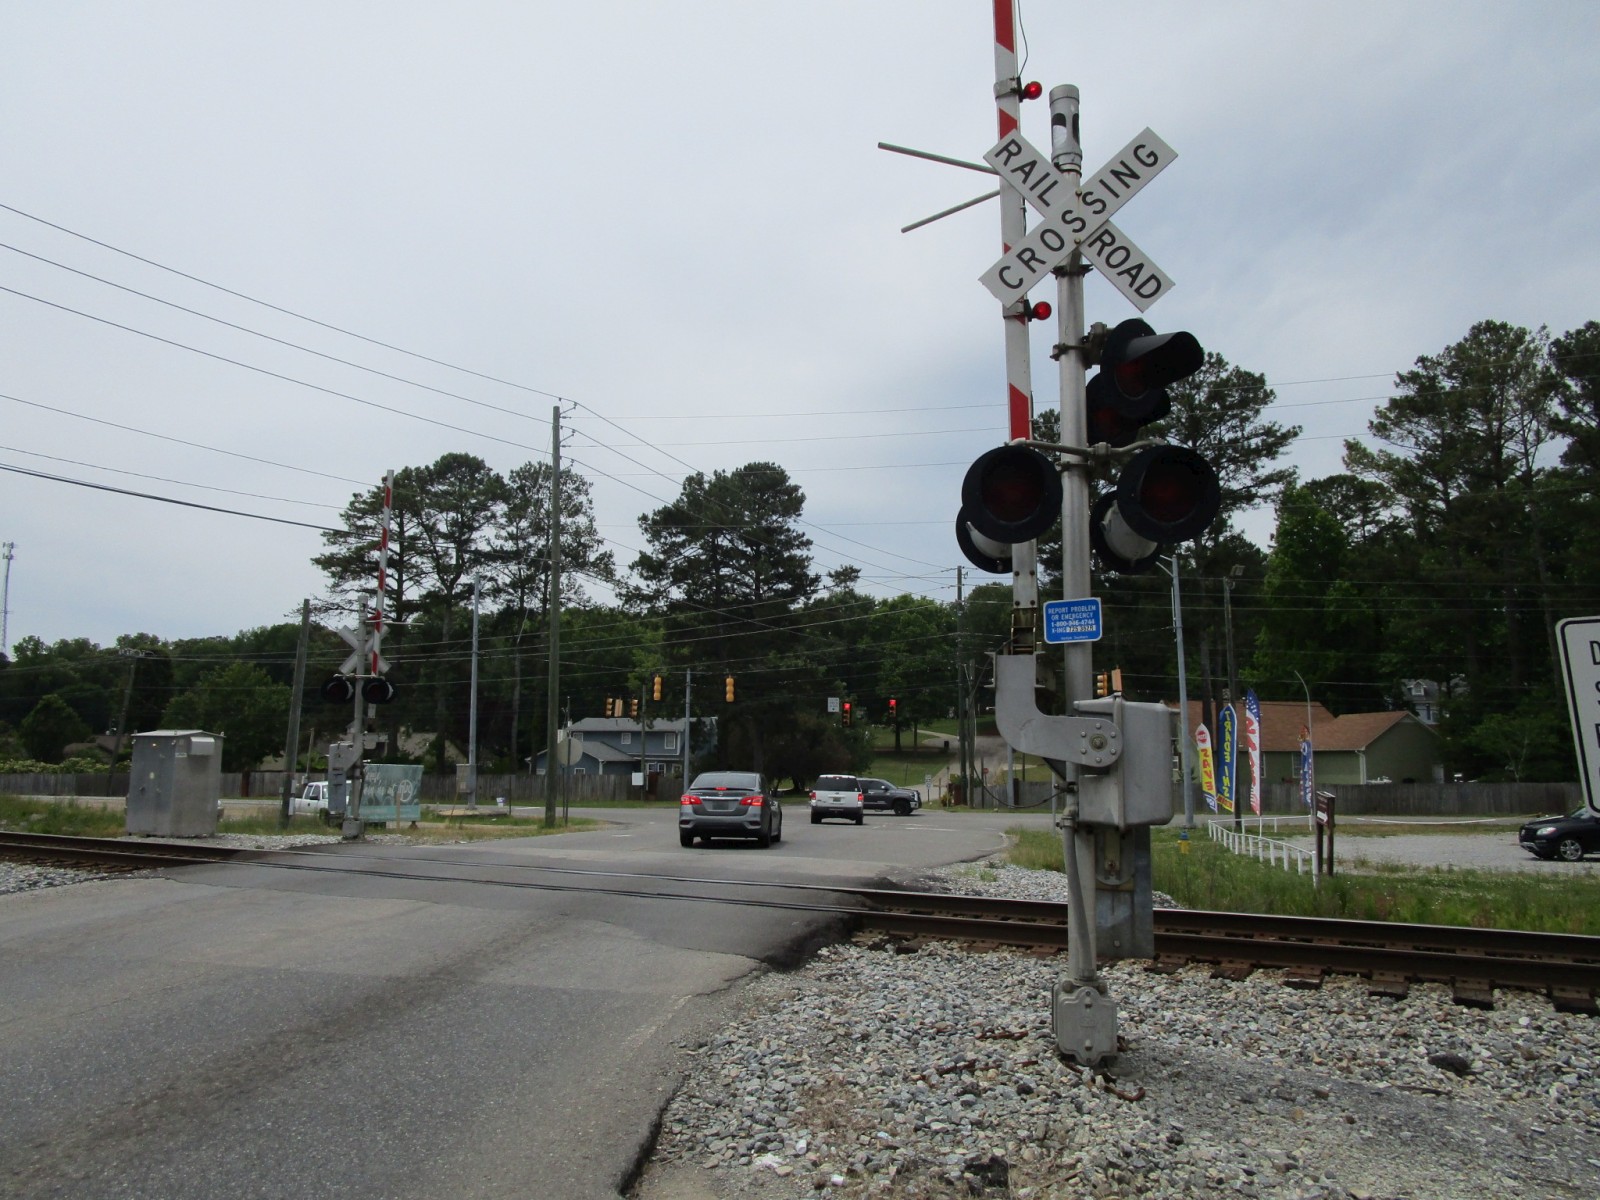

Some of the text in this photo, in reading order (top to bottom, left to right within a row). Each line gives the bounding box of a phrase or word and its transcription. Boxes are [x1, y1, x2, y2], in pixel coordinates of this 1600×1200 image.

[994, 138, 1162, 299] RAIL ROAD
[998, 144, 1159, 290] CROSSING
